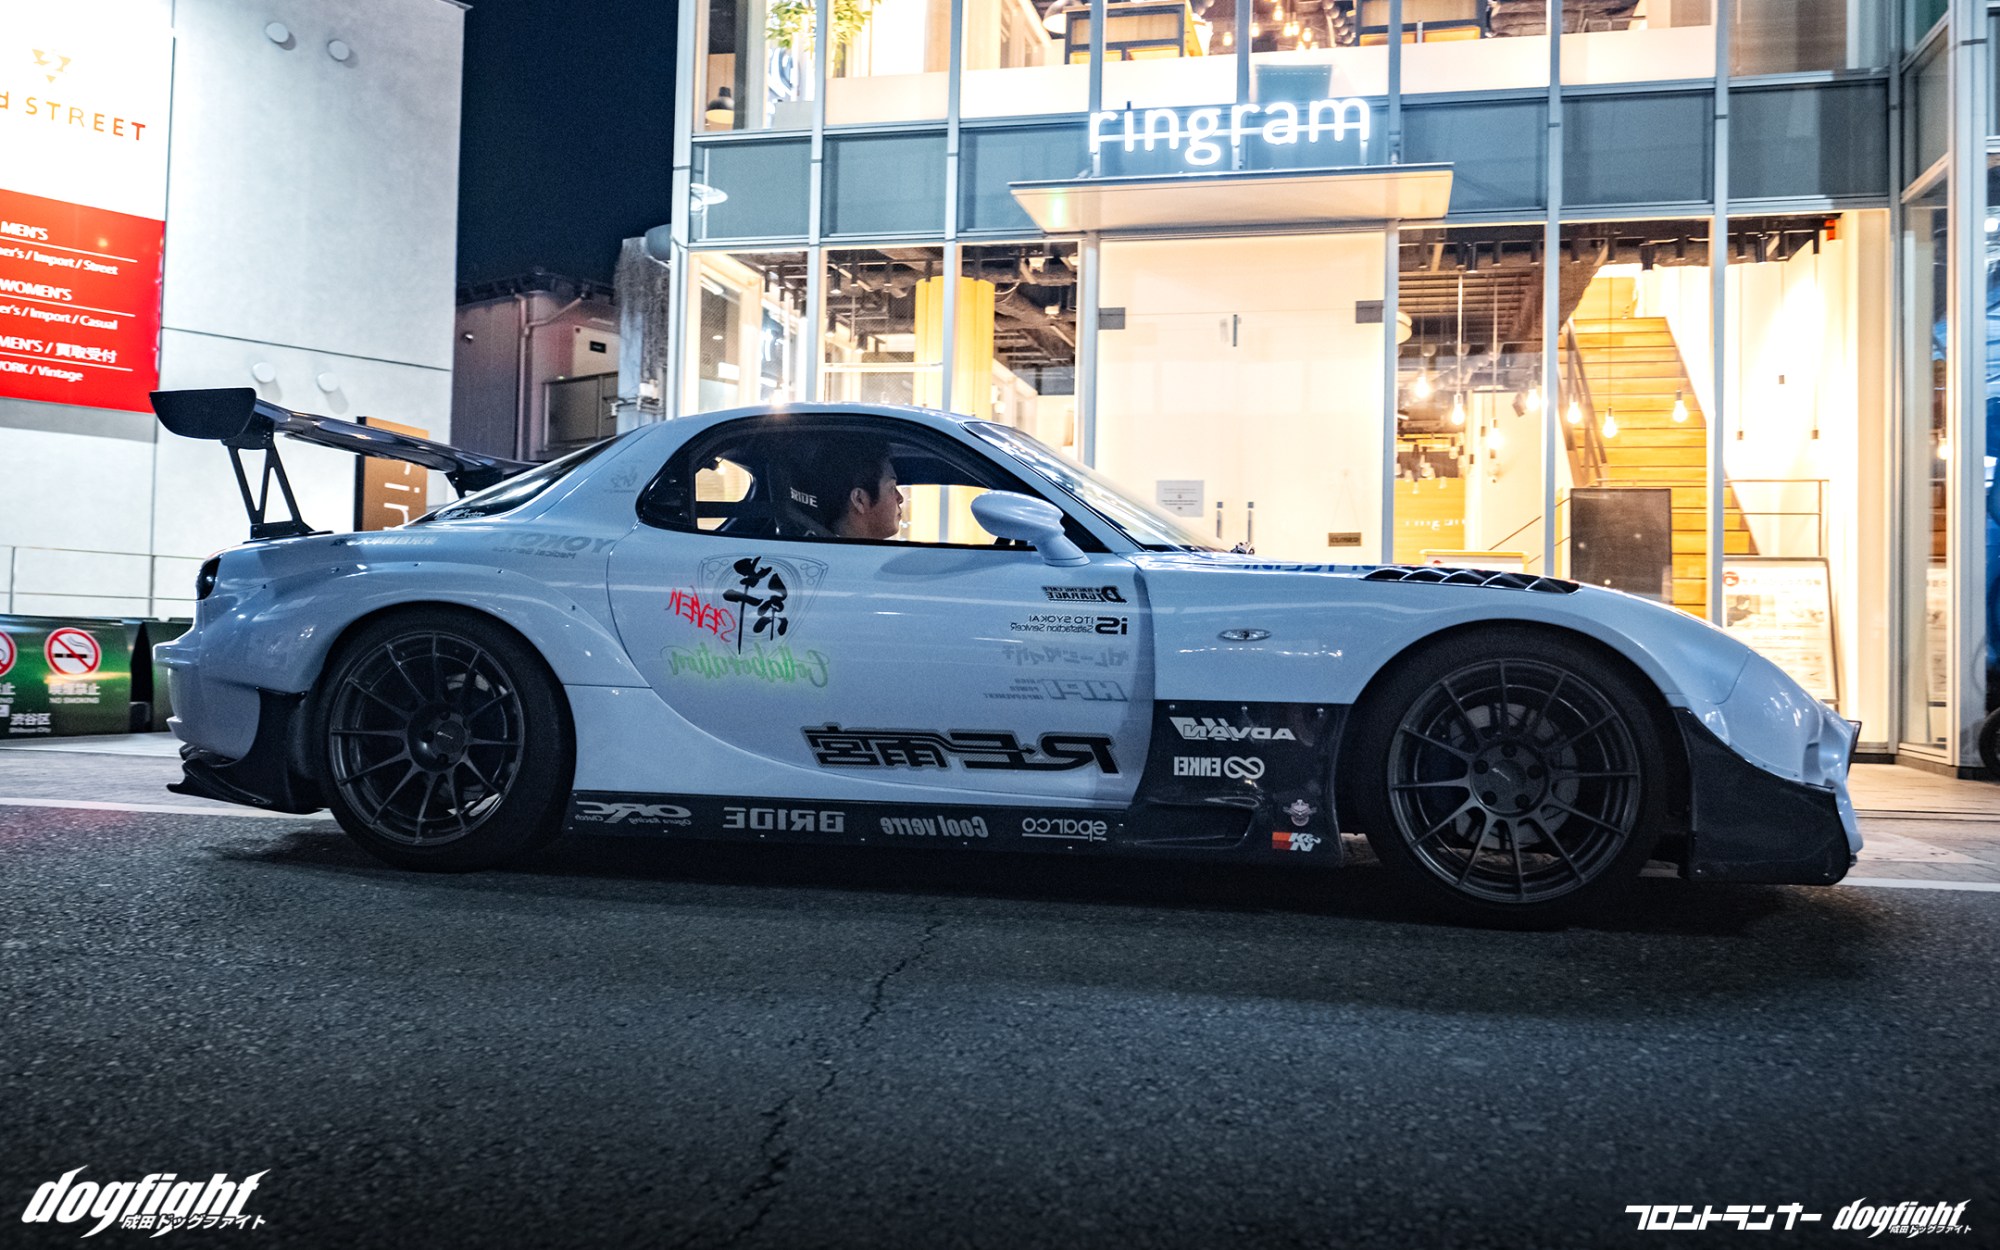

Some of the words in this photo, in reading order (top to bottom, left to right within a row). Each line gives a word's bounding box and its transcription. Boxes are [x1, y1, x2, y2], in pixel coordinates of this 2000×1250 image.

[25, 96, 146, 141] STREET
[1089, 98, 1371, 166] ringram
[1, 220, 49, 241] MEN'S
[33, 251, 75, 268] Import
[83, 259, 119, 275] Street
[0, 278, 73, 301] WOMEN'S
[30, 307, 71, 322] Import
[79, 315, 119, 330] Casual
[55, 342, 118, 364] 買取受付
[37, 365, 84, 382] Vintage
[10, 713, 51, 726] 渋谷区
[1288, 832, 1322, 852] K&N
